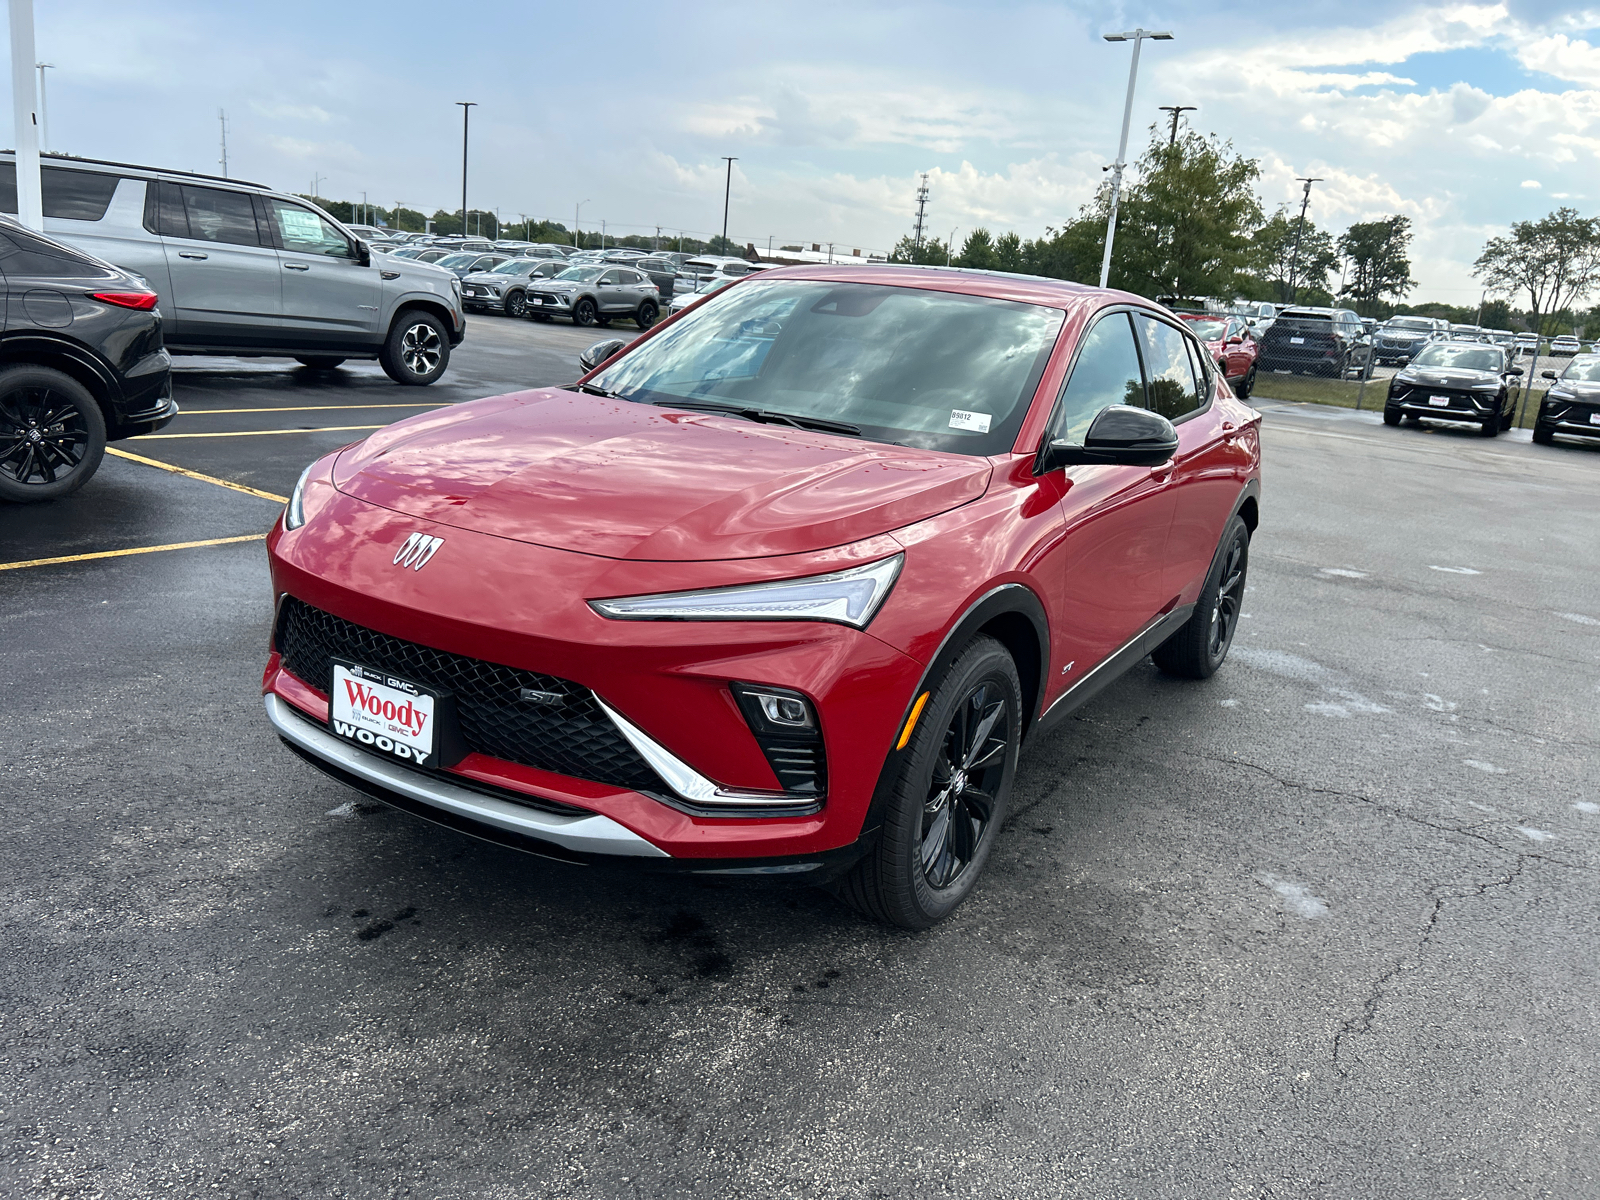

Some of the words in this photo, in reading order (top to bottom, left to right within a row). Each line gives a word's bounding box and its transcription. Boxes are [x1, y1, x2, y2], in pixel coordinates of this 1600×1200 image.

[363, 671, 382, 681] BUICK
[387, 677, 414, 693] GMC
[343, 678, 428, 737] Woody
[525, 690, 563, 705] ST
[361, 715, 382, 726] BUICK
[388, 723, 410, 737] GMC
[333, 719, 429, 766] WOODY
